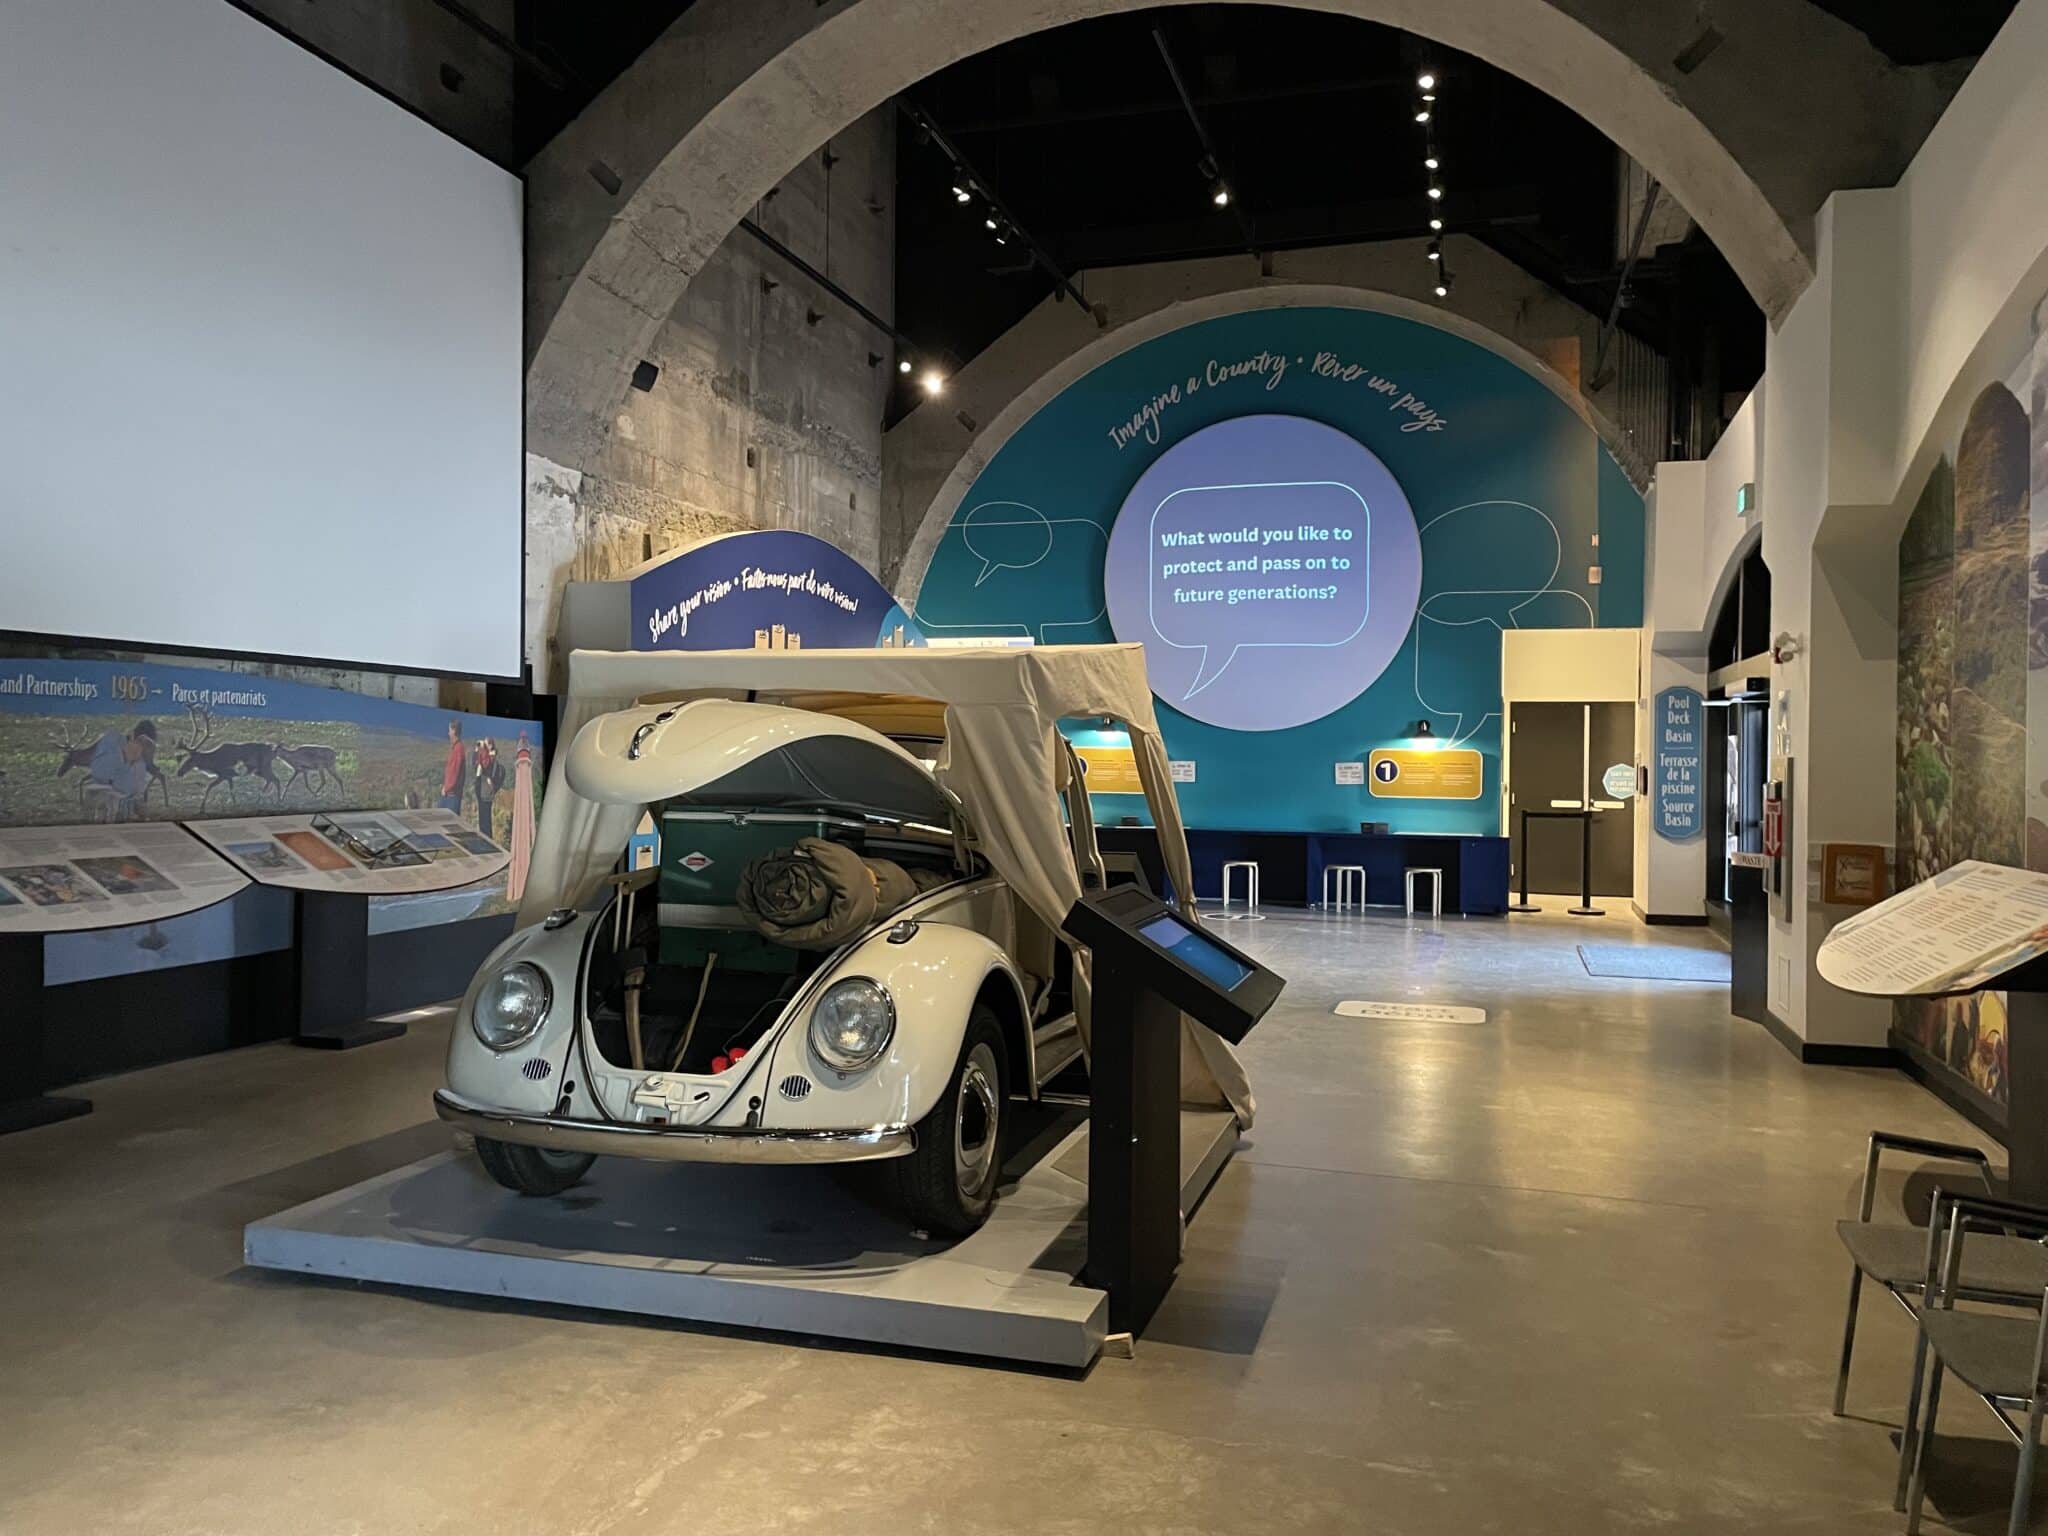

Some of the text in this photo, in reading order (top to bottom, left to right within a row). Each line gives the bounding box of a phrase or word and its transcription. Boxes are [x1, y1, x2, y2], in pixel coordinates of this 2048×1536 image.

[1109, 351, 1447, 450] Imagine a Country Rêver un pays
[1161, 526, 1353, 547] What would you like to
[1163, 556, 1351, 579] protect and pass on to
[1174, 584, 1338, 605] future generations?
[650, 605, 678, 643] Share
[680, 590, 702, 637] your
[704, 580, 732, 604] vision
[786, 572, 807, 596] part
[806, 568, 816, 594] de
[0, 674, 266, 706] and Partnerships 1965 Parcs et partenariats
[1668, 695, 1690, 709] Pool
[1668, 710, 1690, 724] Deck
[1665, 729, 1692, 743] Basin
[1660, 753, 1698, 767] Terrasse
[1380, 763, 1391, 780] 1
[1667, 767, 1690, 781] de la
[1661, 783, 1695, 796] piscine
[1663, 799, 1694, 813] Source
[1665, 813, 1691, 826] Basin
